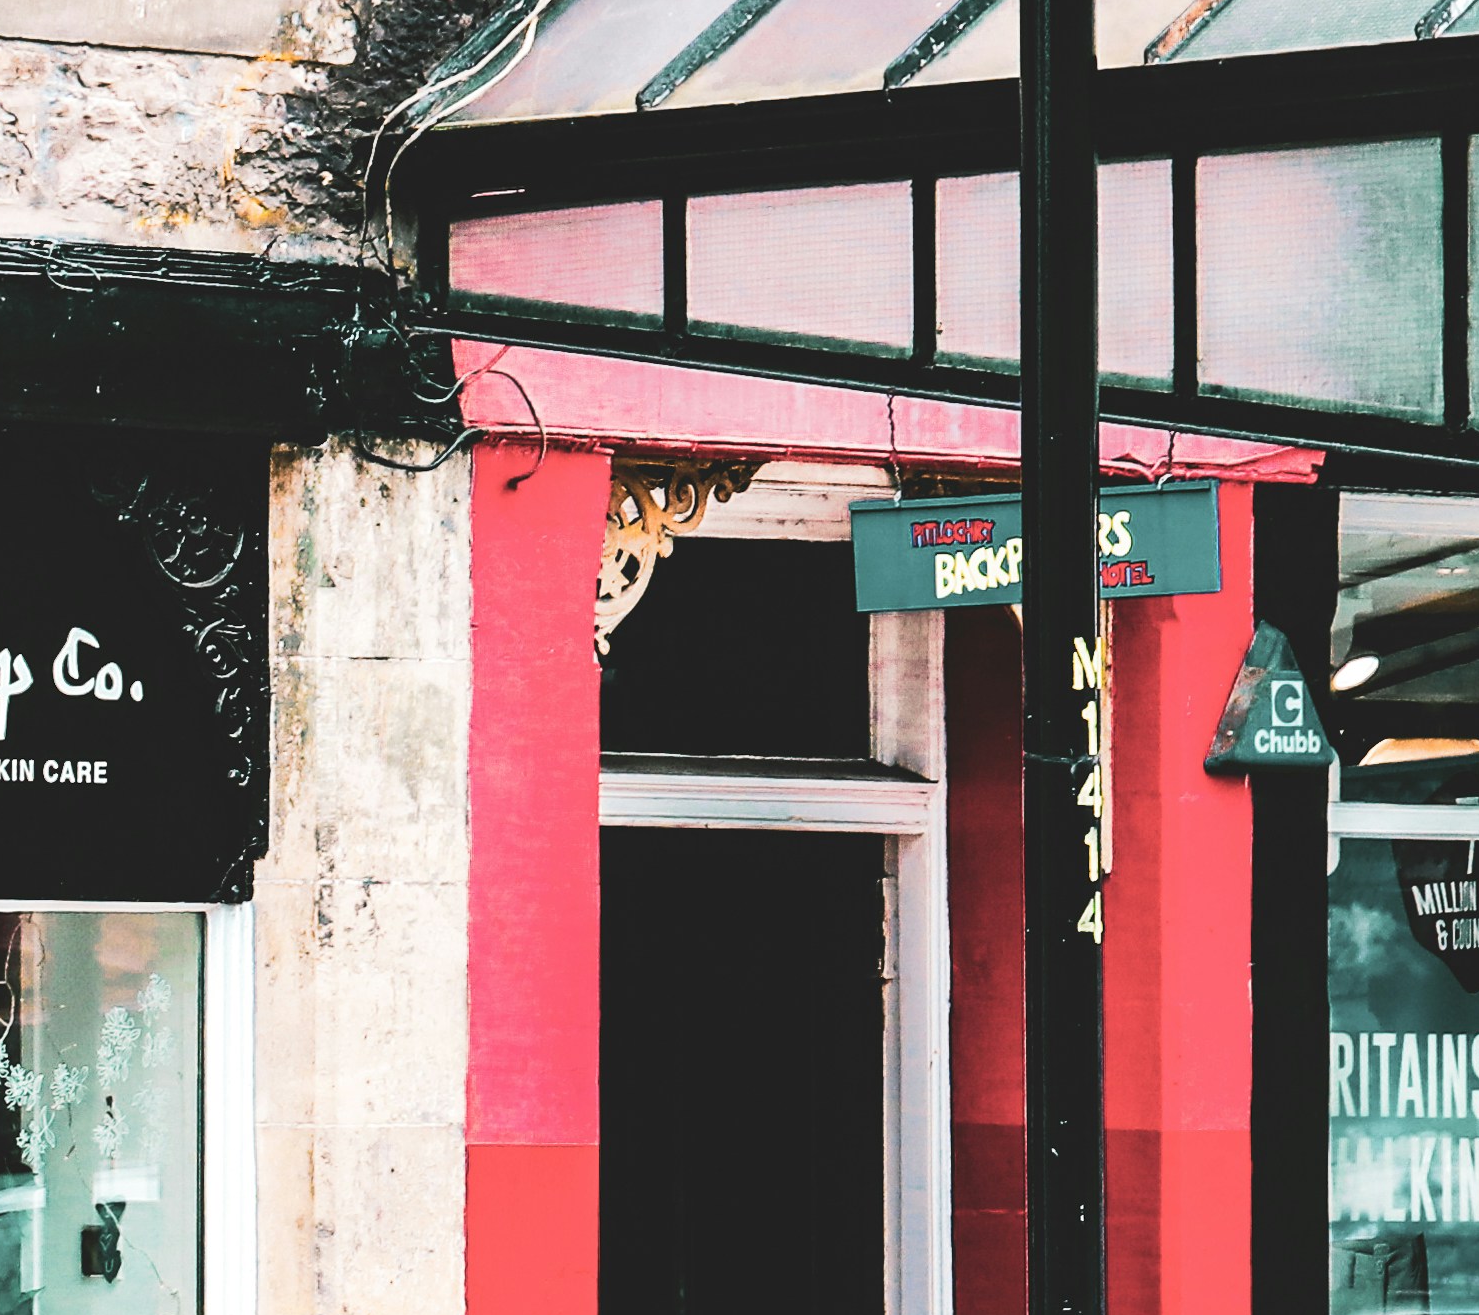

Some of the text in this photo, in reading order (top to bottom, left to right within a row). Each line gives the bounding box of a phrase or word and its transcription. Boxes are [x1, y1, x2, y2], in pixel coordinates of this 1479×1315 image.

[911, 519, 995, 547] PITLOCHRY
[935, 510, 1133, 599] BACKPRS
[53, 627, 143, 701] Co.
[1254, 728, 1322, 756] Chubb
[43, 760, 107, 784] CARE
[1411, 882, 1477, 916] MILLION
[1435, 919, 1448, 951] &
